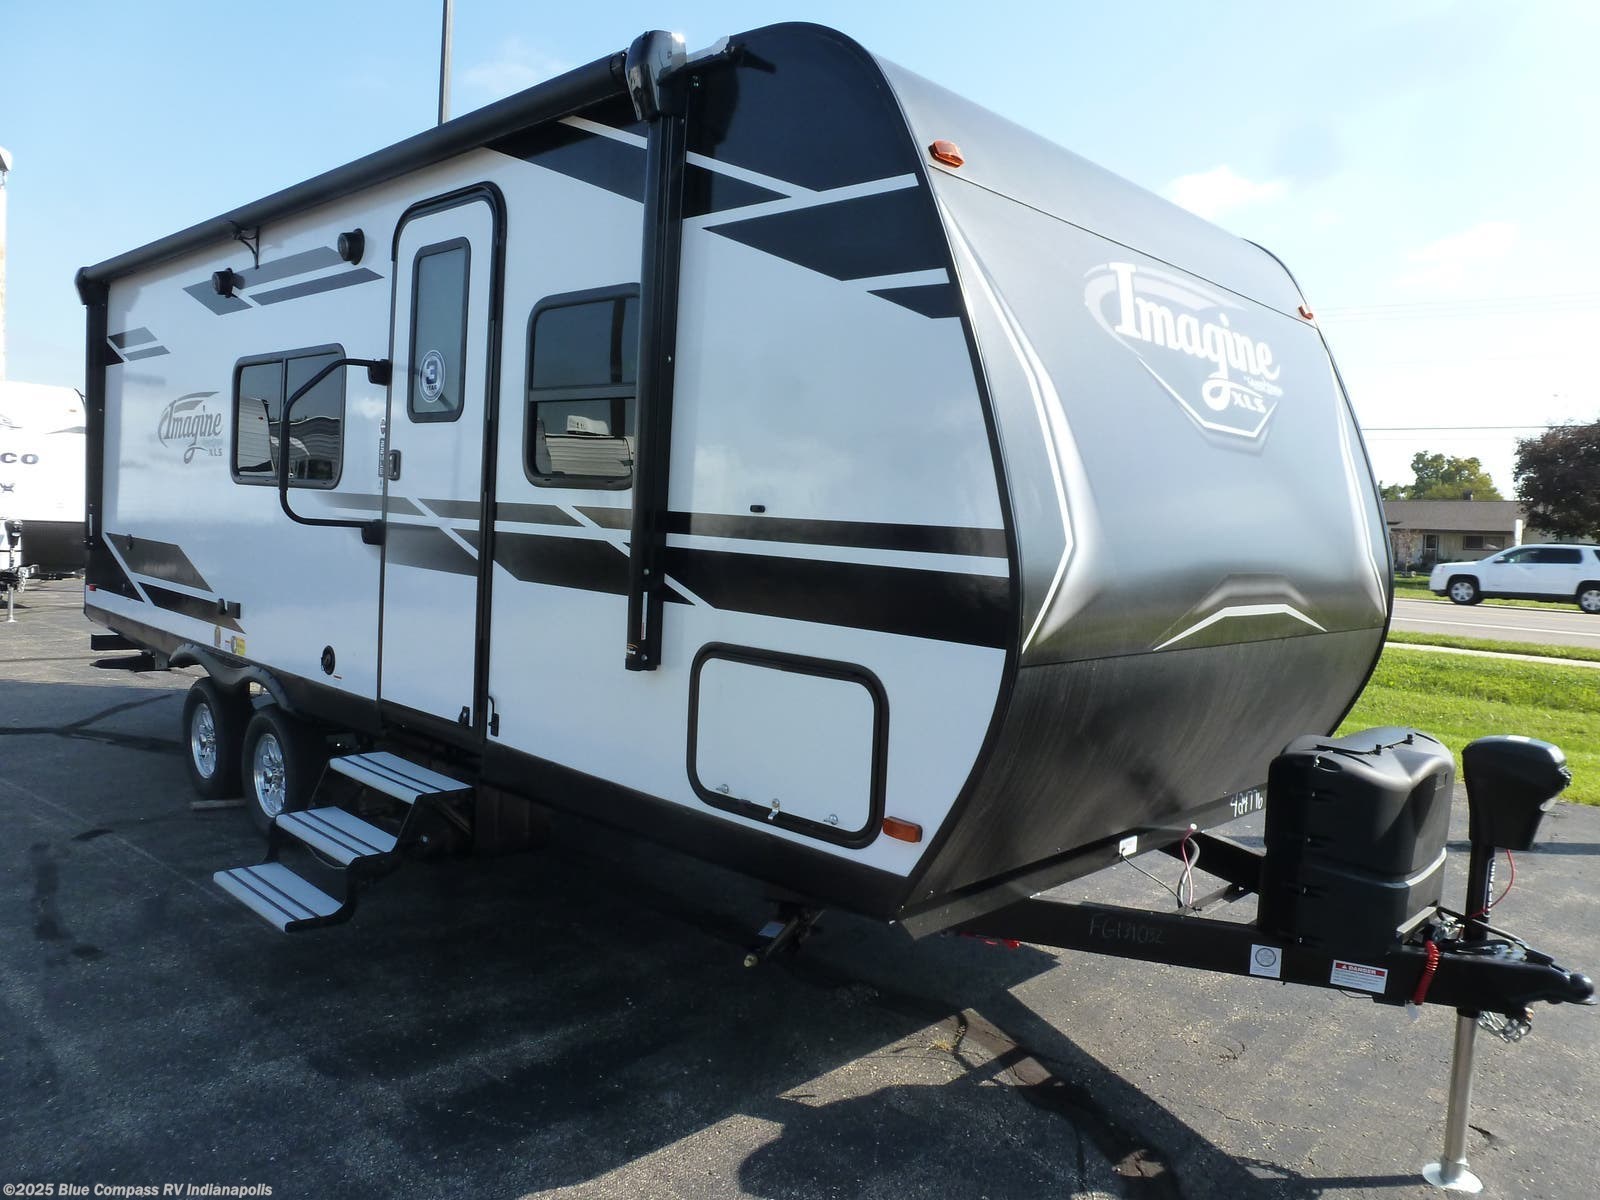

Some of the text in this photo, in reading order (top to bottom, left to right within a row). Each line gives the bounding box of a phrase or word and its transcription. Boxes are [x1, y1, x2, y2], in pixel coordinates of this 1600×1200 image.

[1109, 262, 1281, 411] Imagine
[426, 360, 438, 384] 3
[1230, 390, 1266, 414] XLS
[162, 400, 222, 464] Imagine
[1348, 964, 1377, 976] DANGER
